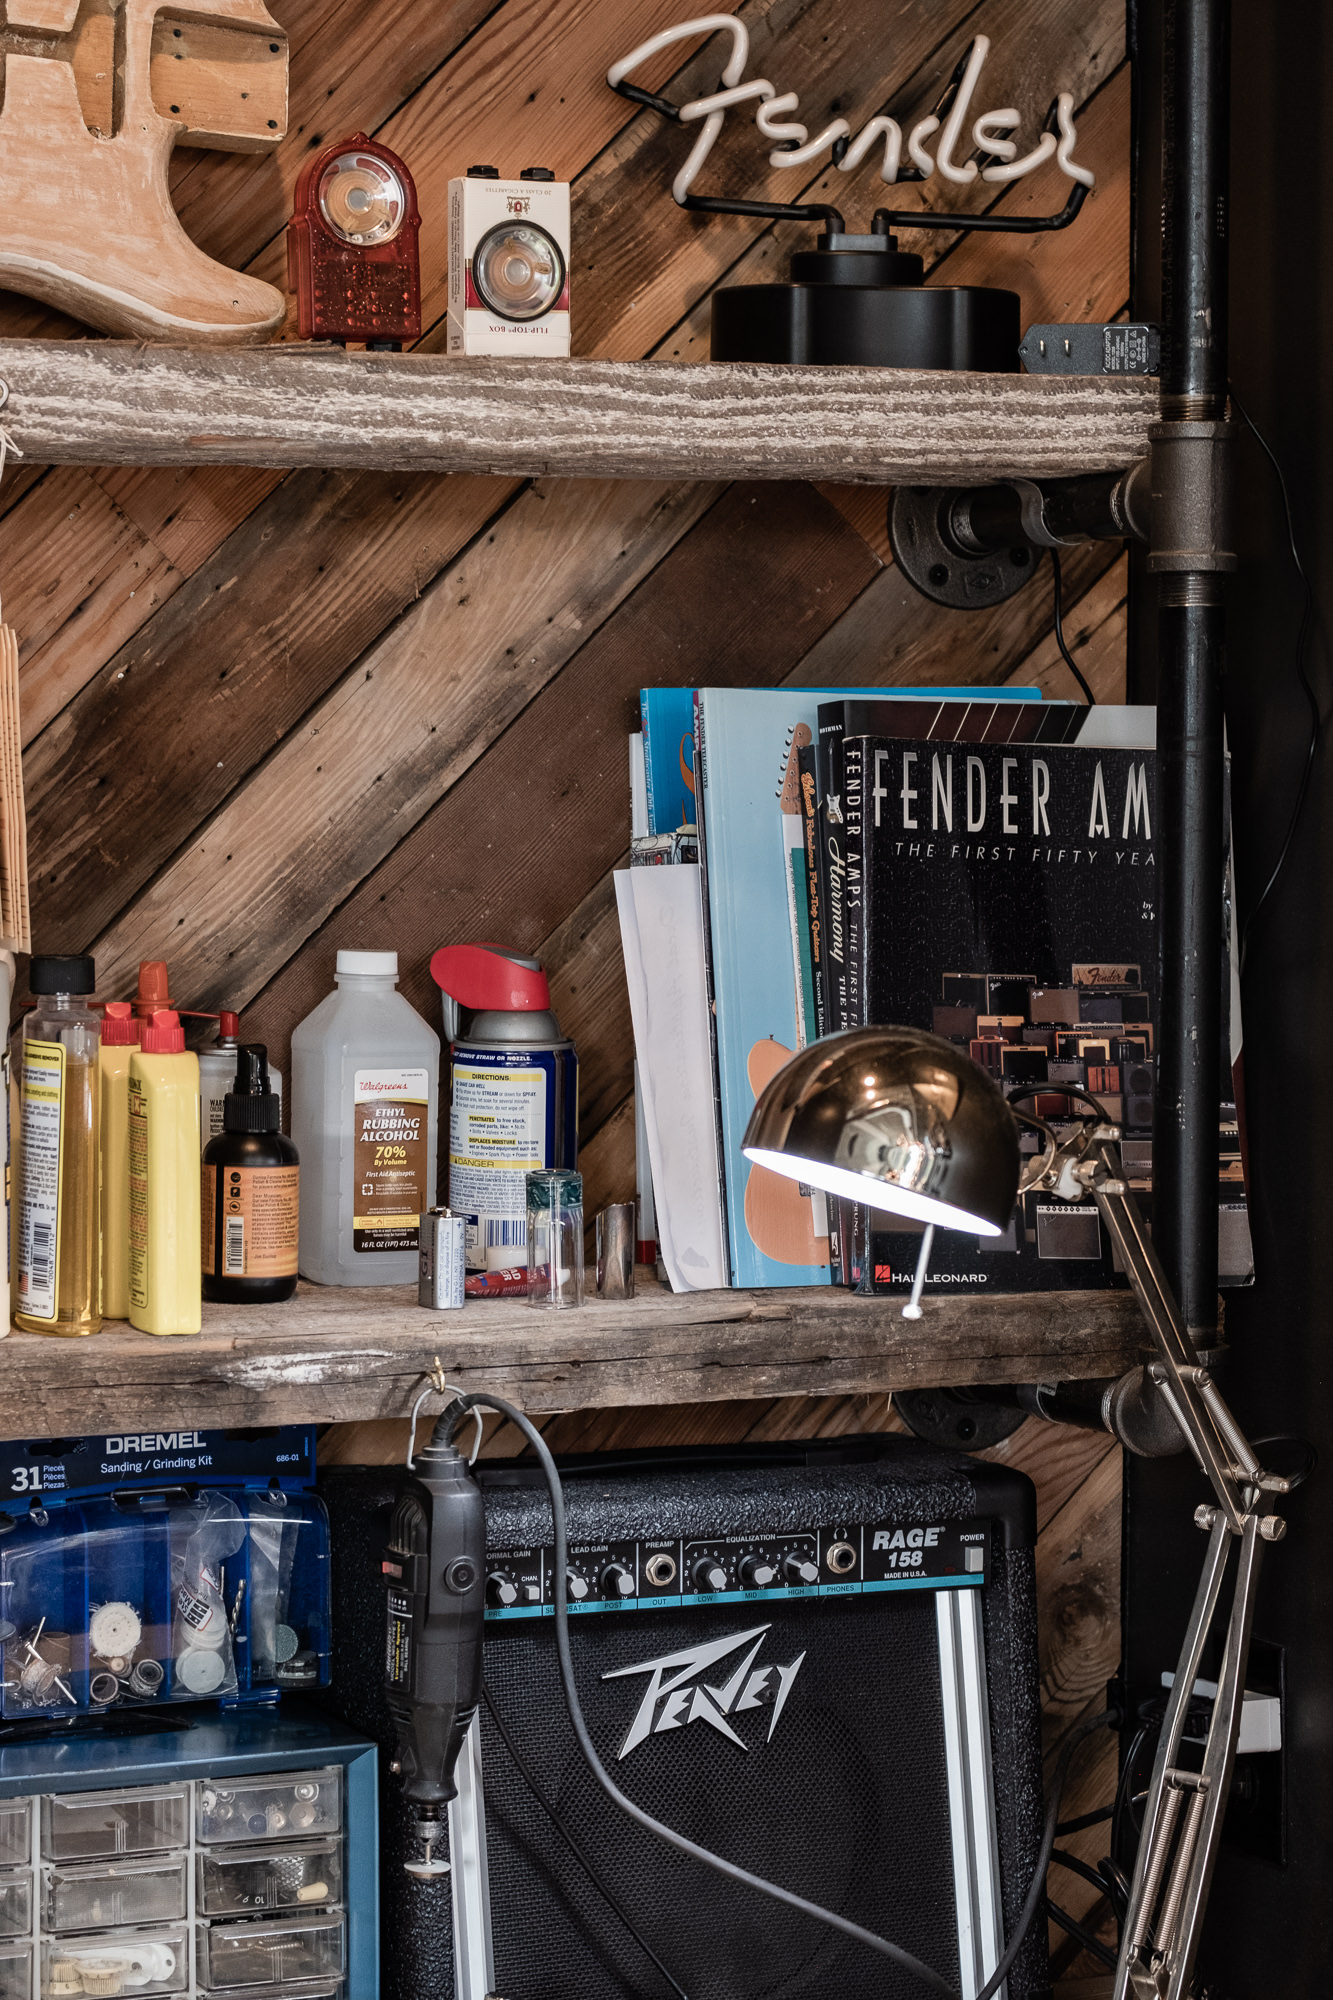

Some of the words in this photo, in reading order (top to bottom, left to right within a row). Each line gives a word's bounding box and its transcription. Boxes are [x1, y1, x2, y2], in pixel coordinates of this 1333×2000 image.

[607, 13, 1096, 204] Fender
[643, 741, 652, 788] Stratocaster
[701, 747, 709, 789] TELECASTER
[846, 750, 861, 835] FENDER
[871, 748, 1052, 836] FENDER
[805, 820, 816, 868] Fabulous
[895, 841, 936, 859] THE
[951, 844, 1016, 862] FIRST
[1031, 848, 1098, 866] FIFTY
[847, 852, 861, 909] AMPS
[809, 871, 819, 917] Flat-Top
[1143, 901, 1153, 910] by
[828, 836, 845, 963] Harmony
[839, 976, 847, 1006] THE
[811, 920, 821, 963] Guitars
[850, 924, 858, 953] THE
[850, 962, 858, 1004] FIRST
[1088, 967, 1125, 986] Fender
[815, 971, 823, 1004] Second
[360, 1081, 408, 1093] Walgreens
[376, 1108, 405, 1116] ETHYL
[363, 1118, 420, 1129] RUBBING
[360, 1131, 420, 1142] ALCOHOL
[375, 1146, 406, 1158] 70%
[374, 1159, 382, 1167] By
[458, 1158, 494, 1168] DANGER
[389, 1170, 415, 1178] Antiseptic
[385, 1240, 398, 1248] (1PT)
[892, 1273, 915, 1282] HAL
[925, 1274, 987, 1282] LEONARD
[105, 1430, 207, 1455] DREMEL
[100, 1461, 142, 1474] Sanding
[144, 1459, 151, 1471] /
[153, 1458, 196, 1471] Grinding
[198, 1455, 213, 1467] Kit
[276, 1453, 299, 1463] 686-01
[43, 1464, 65, 1473] Pieces
[43, 1472, 65, 1481] Pièces
[11, 1466, 43, 1491] 31
[43, 1481, 65, 1490] Piezas
[726, 1534, 776, 1543] EQUALIZATION
[486, 1550, 512, 1560] ORMAL
[571, 1546, 590, 1554] LEAD
[889, 1551, 923, 1568] 158
[601, 1623, 807, 1761] PEAVEY
